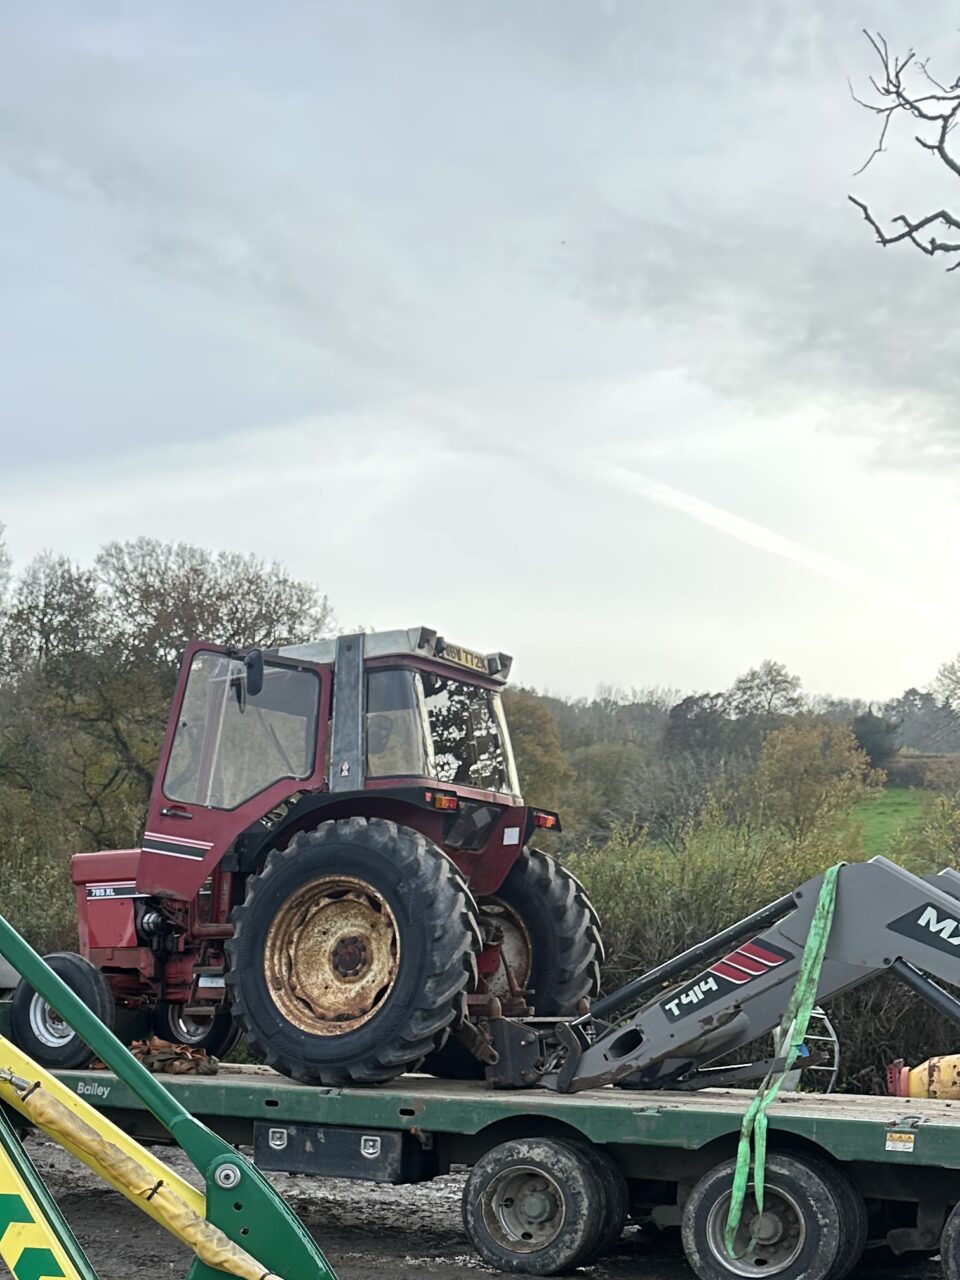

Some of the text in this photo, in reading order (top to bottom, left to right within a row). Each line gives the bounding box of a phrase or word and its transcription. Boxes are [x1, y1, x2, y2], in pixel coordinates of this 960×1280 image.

[105, 888, 115, 896] XL
[664, 976, 719, 1016] T414
[76, 1081, 111, 1099] Bailey
